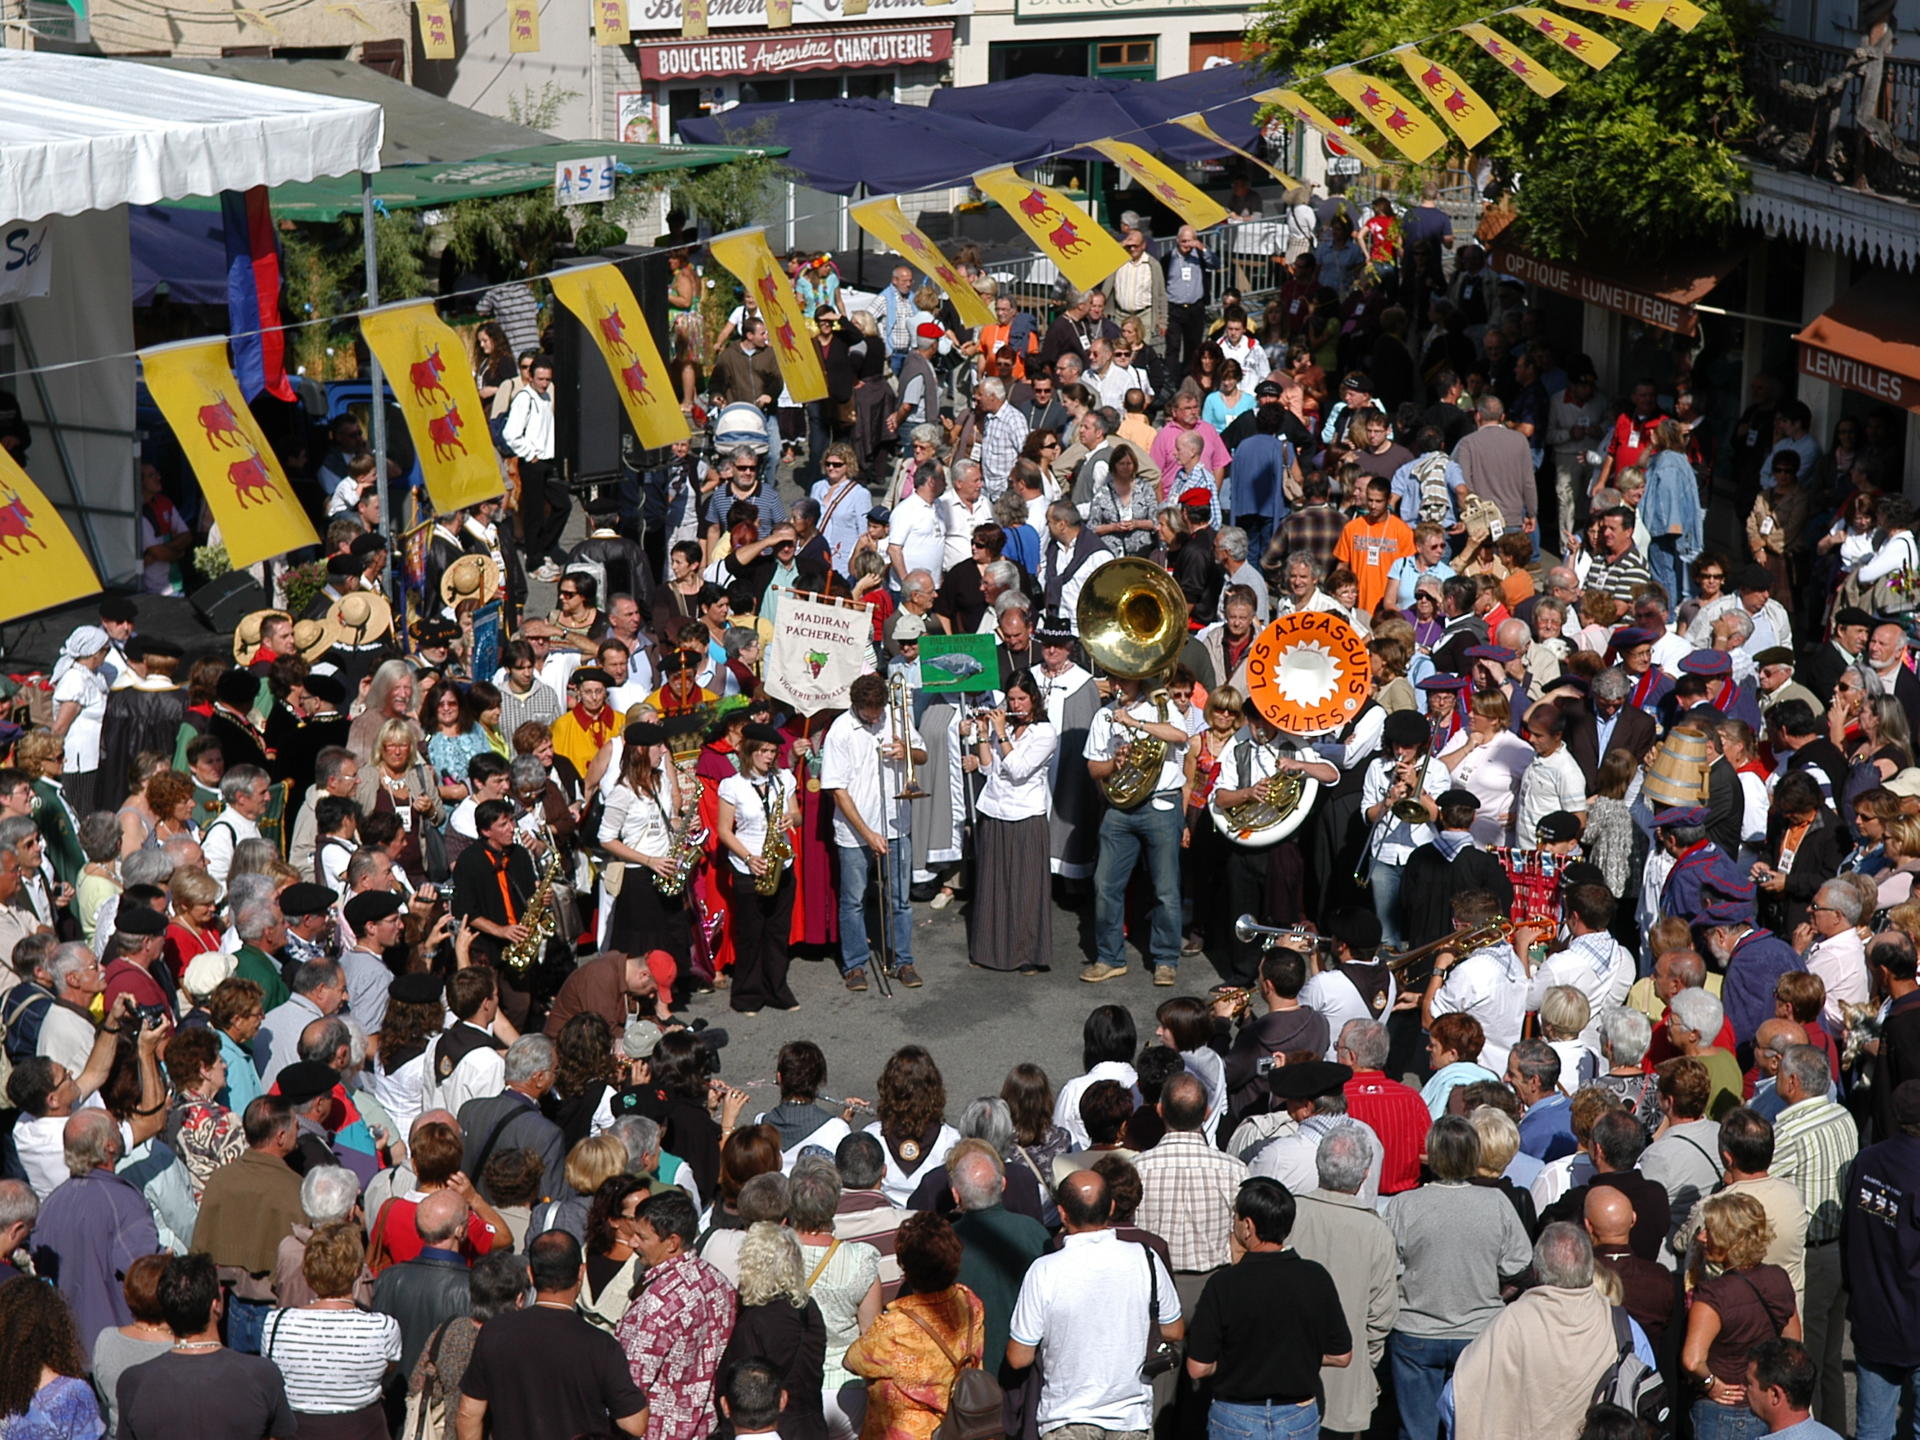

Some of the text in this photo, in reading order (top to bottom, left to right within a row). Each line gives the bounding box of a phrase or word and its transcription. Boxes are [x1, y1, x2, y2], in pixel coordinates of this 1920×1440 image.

[658, 45, 746, 75] BOUCHERIE
[834, 33, 933, 63] CHARCUTERIE
[1505, 253, 1680, 328] OPTIQUE LUNETTERIE
[1805, 348, 1902, 401] LENTILLES
[786, 625, 855, 646] PACHERENC
[794, 612, 850, 629] MADIRAN
[1249, 612, 1368, 695] LOS AIGASSUTS
[779, 676, 847, 700] VIGUERIE ROYALE
[1264, 704, 1345, 732] SALIES
